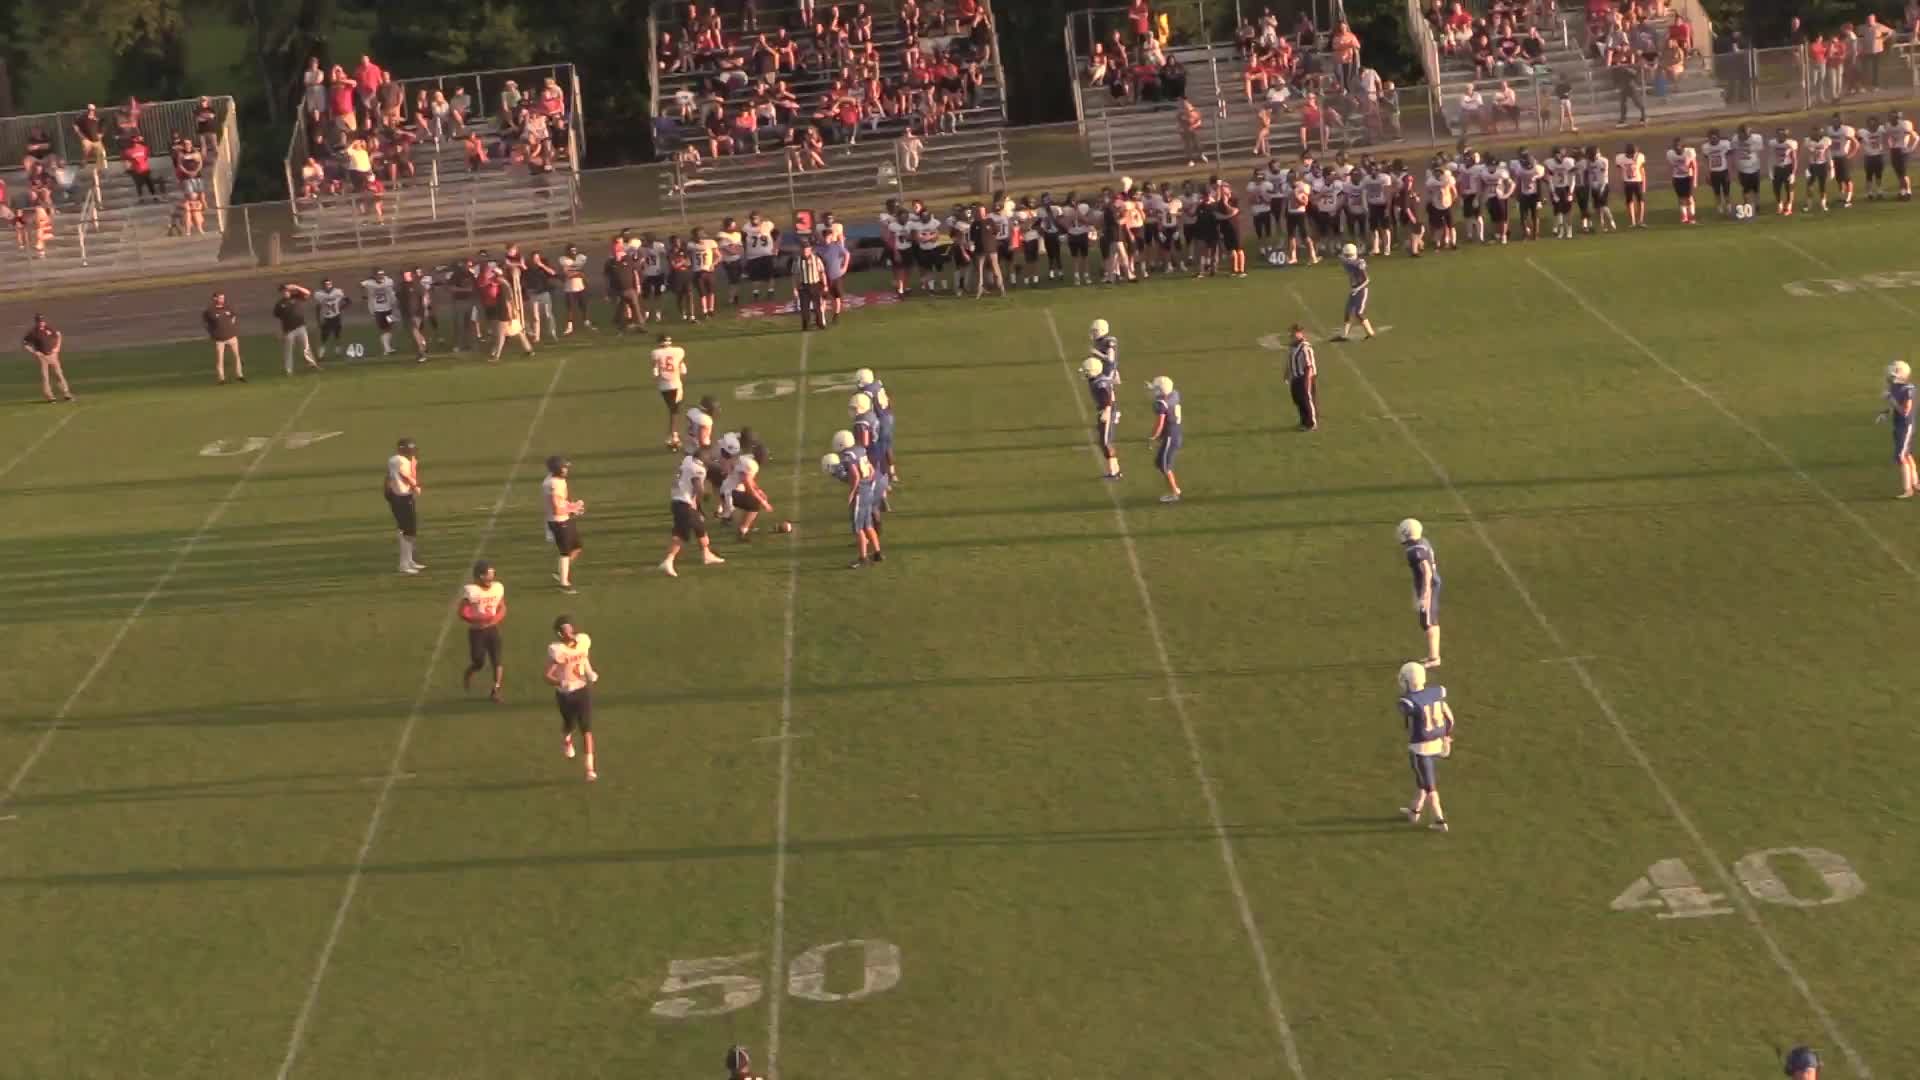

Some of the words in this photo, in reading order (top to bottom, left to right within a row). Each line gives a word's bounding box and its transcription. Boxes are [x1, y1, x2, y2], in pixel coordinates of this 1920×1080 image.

[1735, 203, 1753, 219] 30
[795, 211, 812, 233] 3
[1268, 251, 1286, 264] 40
[345, 343, 364, 358] 40
[1609, 846, 1866, 920] 40
[650, 938, 902, 1018] 50
